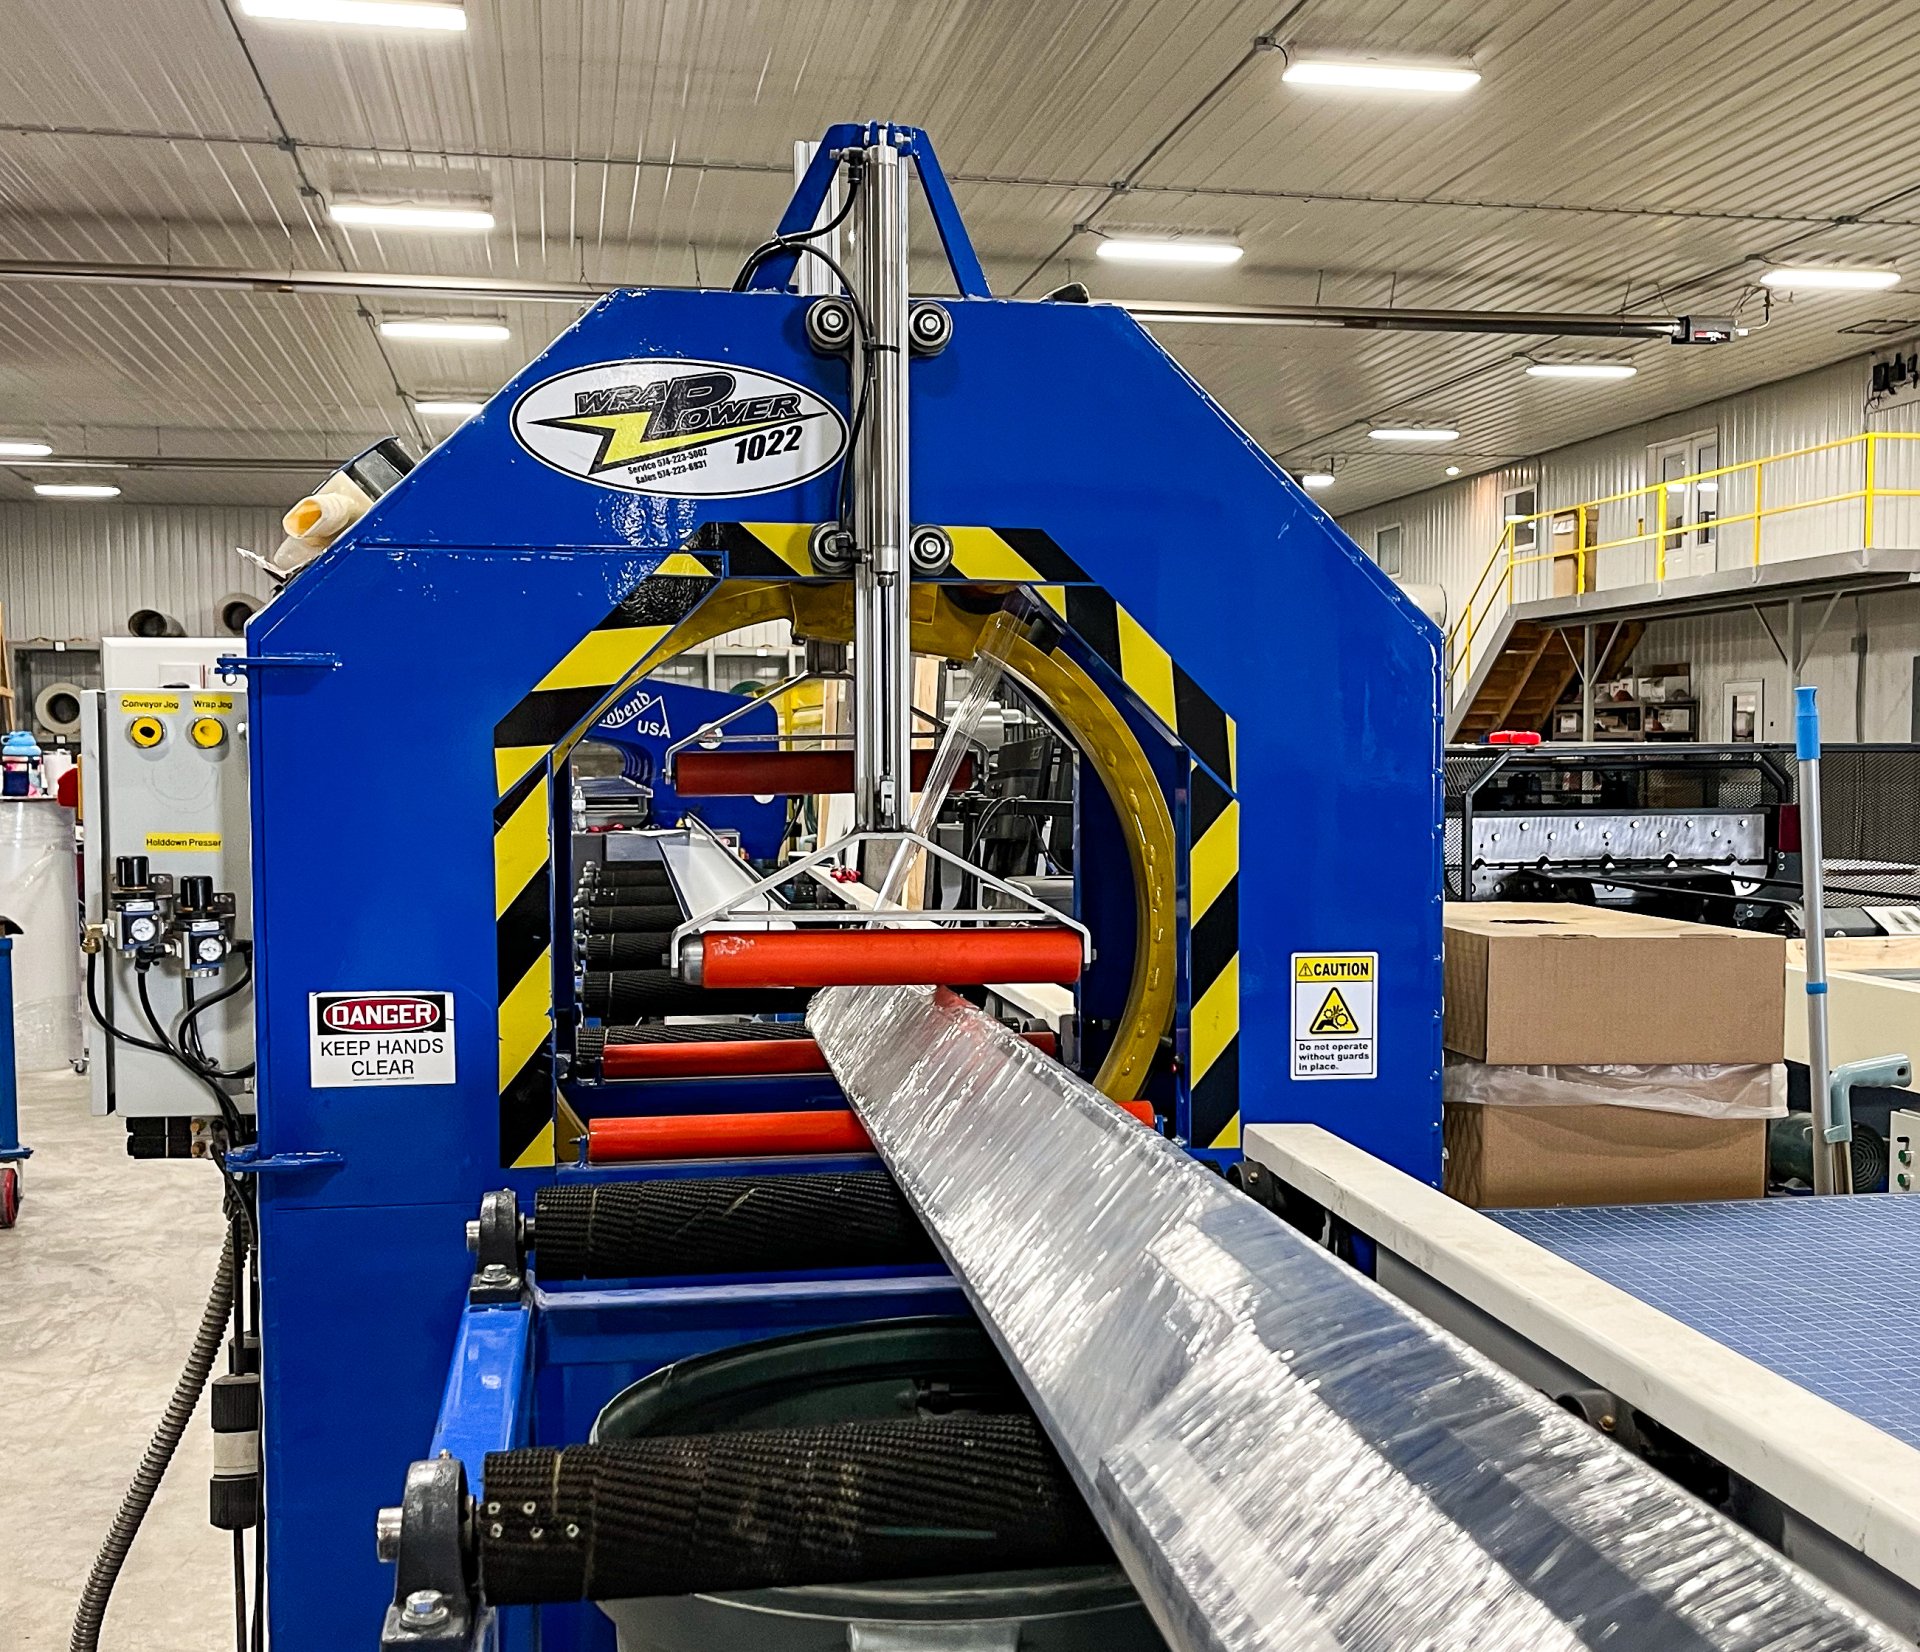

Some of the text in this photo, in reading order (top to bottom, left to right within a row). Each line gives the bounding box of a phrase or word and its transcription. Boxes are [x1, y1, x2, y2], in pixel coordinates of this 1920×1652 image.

[734, 425, 803, 465] 1022
[628, 462, 657, 475] Service
[635, 473, 657, 485] Sales
[122, 699, 179, 709] Conveyor Jog
[194, 700, 233, 710] Wrap Jog
[637, 719, 671, 739] USA
[146, 838, 221, 847] Holddown Presser
[1313, 962, 1369, 977] CAUTION
[332, 1004, 432, 1026] DANGER
[321, 1038, 444, 1056] KEEP HANDS
[1332, 1043, 1368, 1051] operate
[1337, 1052, 1369, 1061] guards
[351, 1059, 414, 1076] CLEAR
[1310, 1063, 1339, 1071] place.
